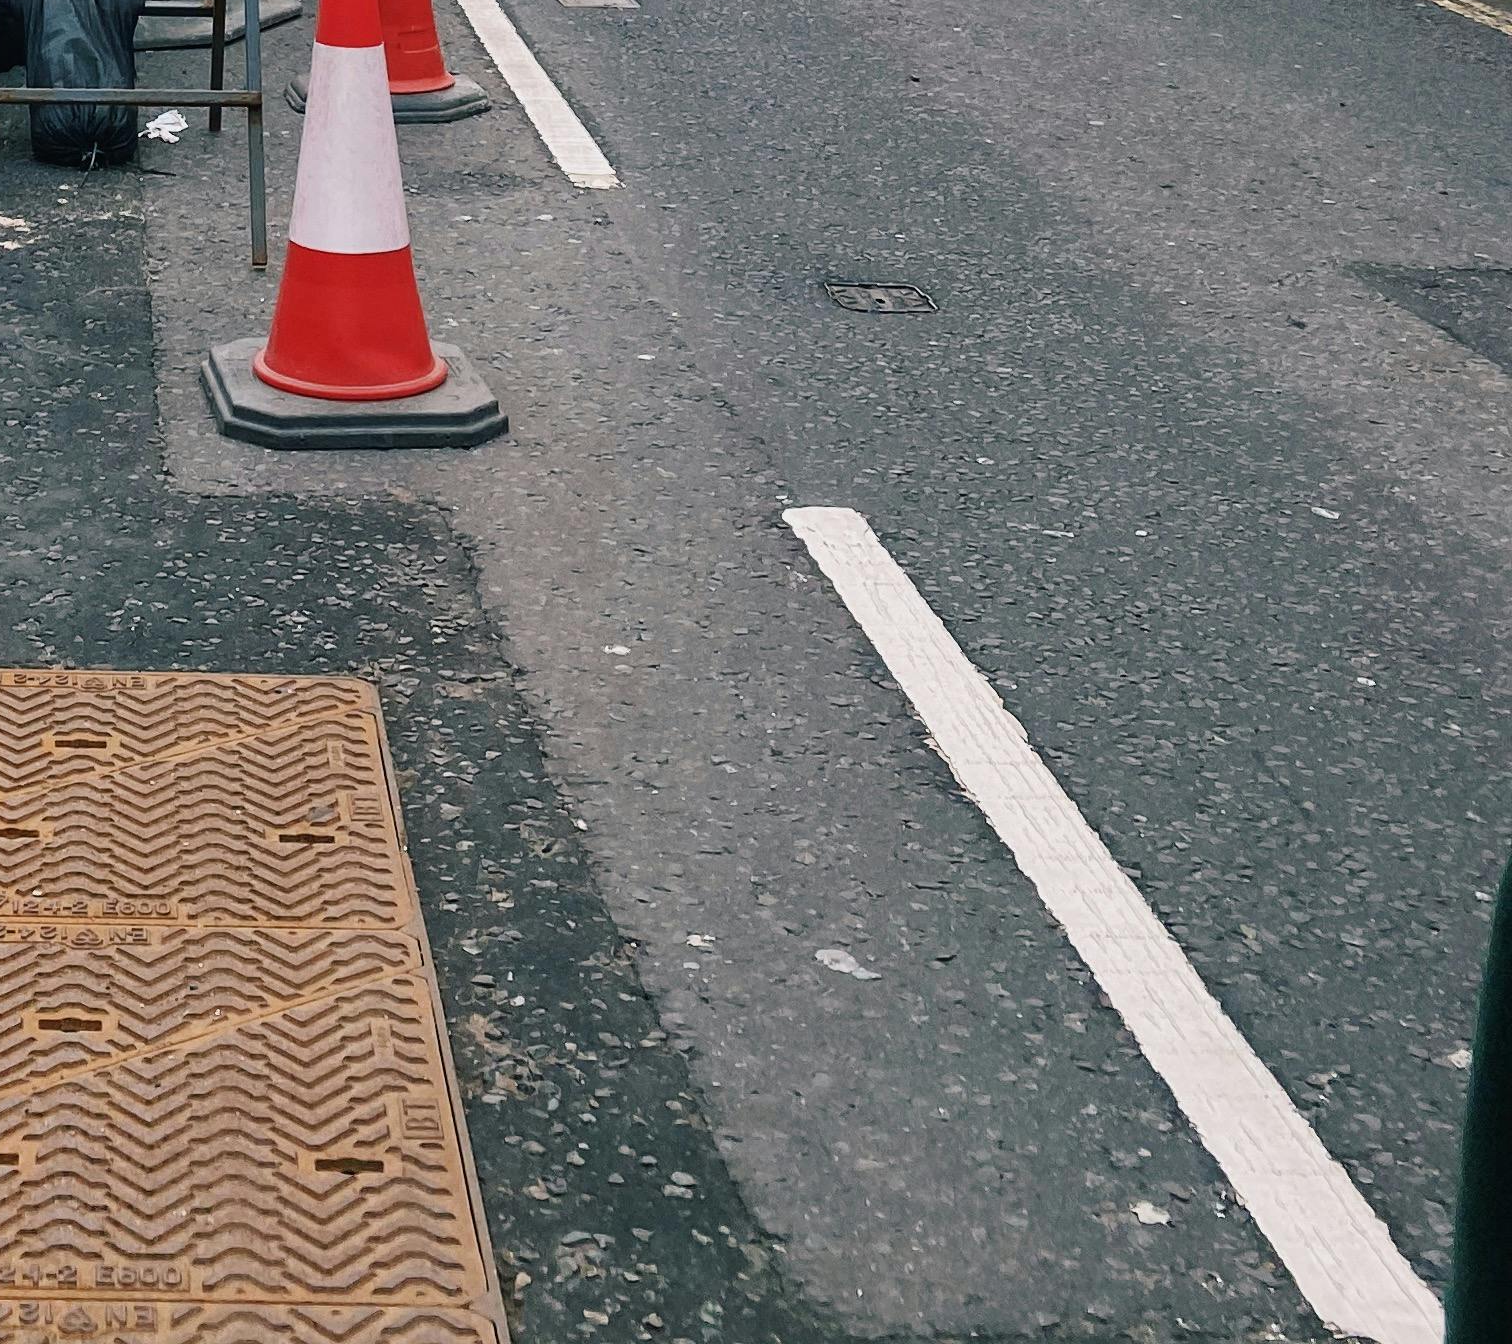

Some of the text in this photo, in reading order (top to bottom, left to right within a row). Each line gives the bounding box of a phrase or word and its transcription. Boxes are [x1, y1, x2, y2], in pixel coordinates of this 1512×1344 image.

[112, 675, 147, 688] EN
[12, 900, 89, 915] 124-2
[102, 900, 172, 916] E600
[108, 926, 150, 942] EN
[403, 1103, 440, 1131] BT
[94, 1265, 184, 1288] E600
[104, 1303, 158, 1330] EN
